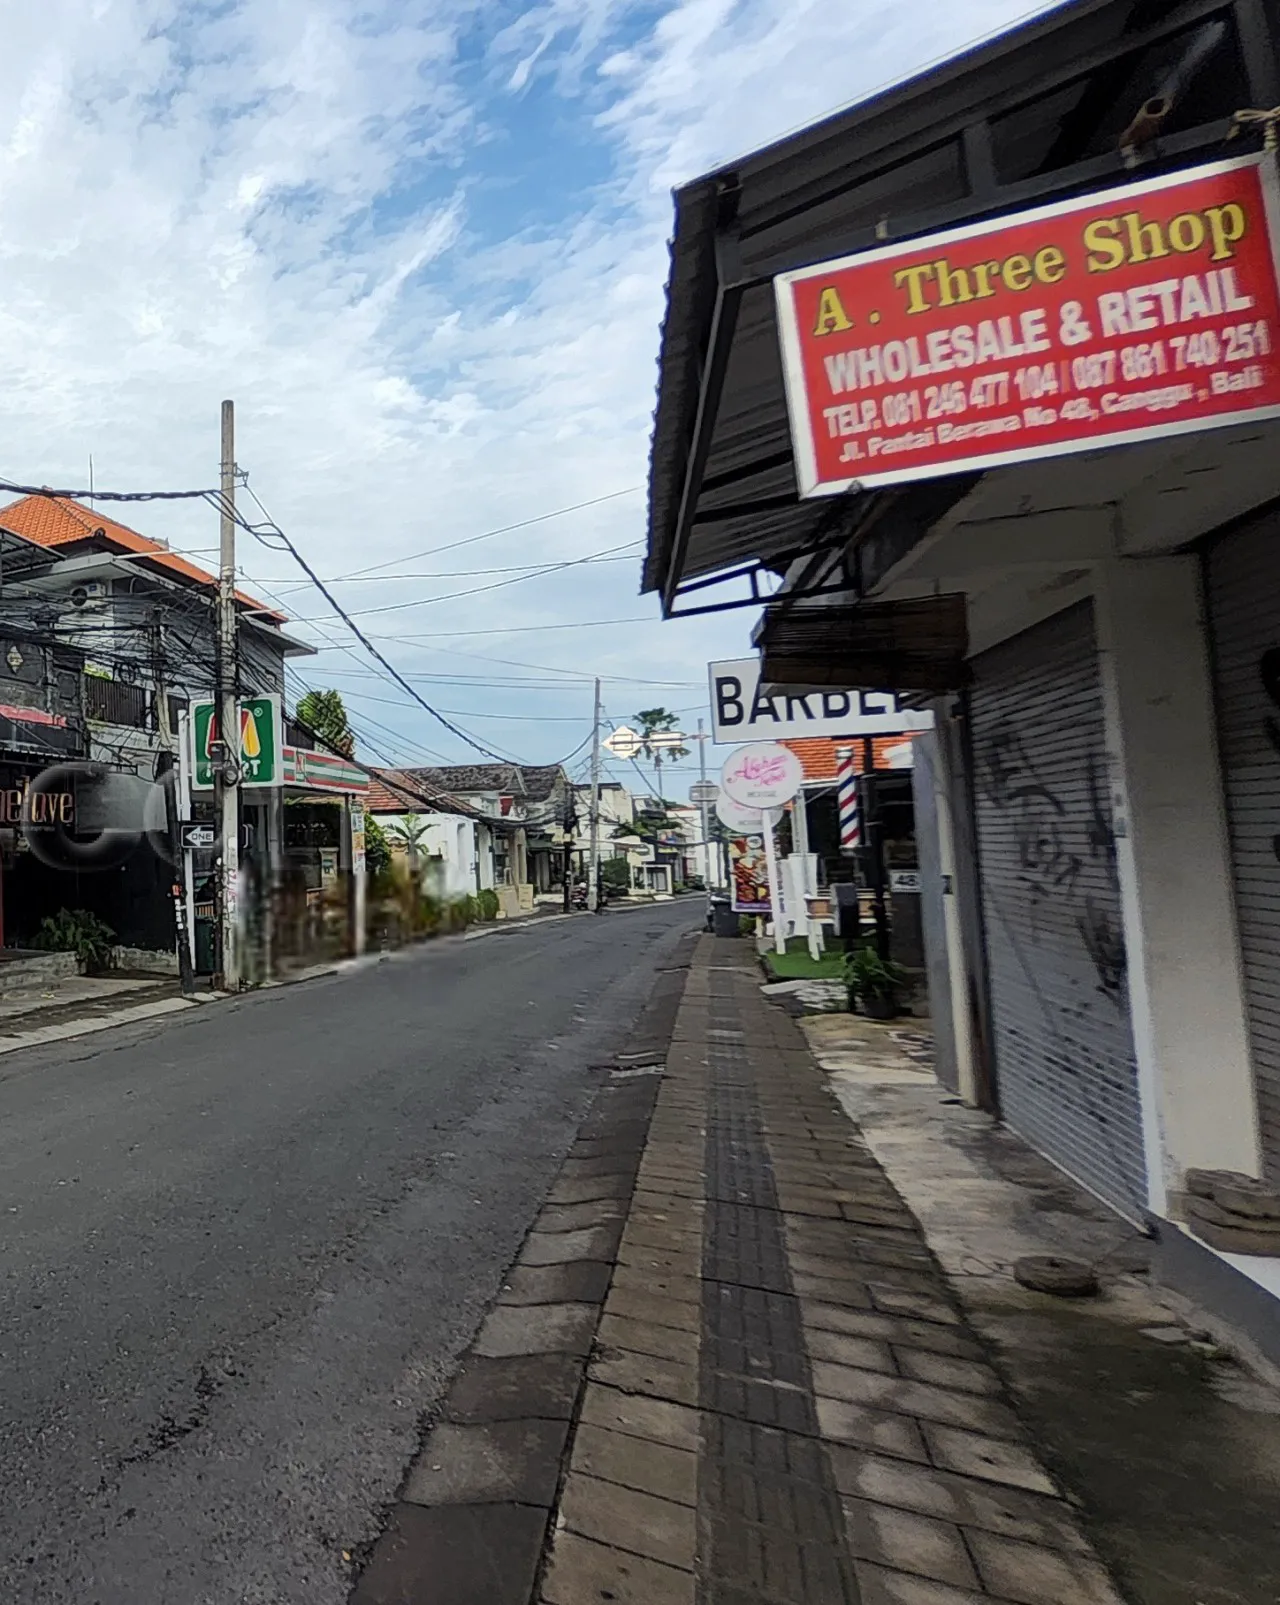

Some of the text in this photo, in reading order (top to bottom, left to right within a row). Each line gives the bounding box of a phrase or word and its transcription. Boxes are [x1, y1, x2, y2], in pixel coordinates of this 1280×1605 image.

[814, 287, 854, 336] A
[894, 246, 1065, 315] Three
[1083, 202, 1246, 274] Shop
[823, 267, 1254, 395] WHOLESALE & RETAIL
[823, 399, 882, 438] TELP.
[969, 371, 1010, 408] 477
[1120, 340, 1169, 381] 861
[1169, 330, 1221, 372] 740
[1221, 320, 1270, 362] 251
[1211, 364, 1265, 395] Bali
[191, 832, 212, 841] ONE
